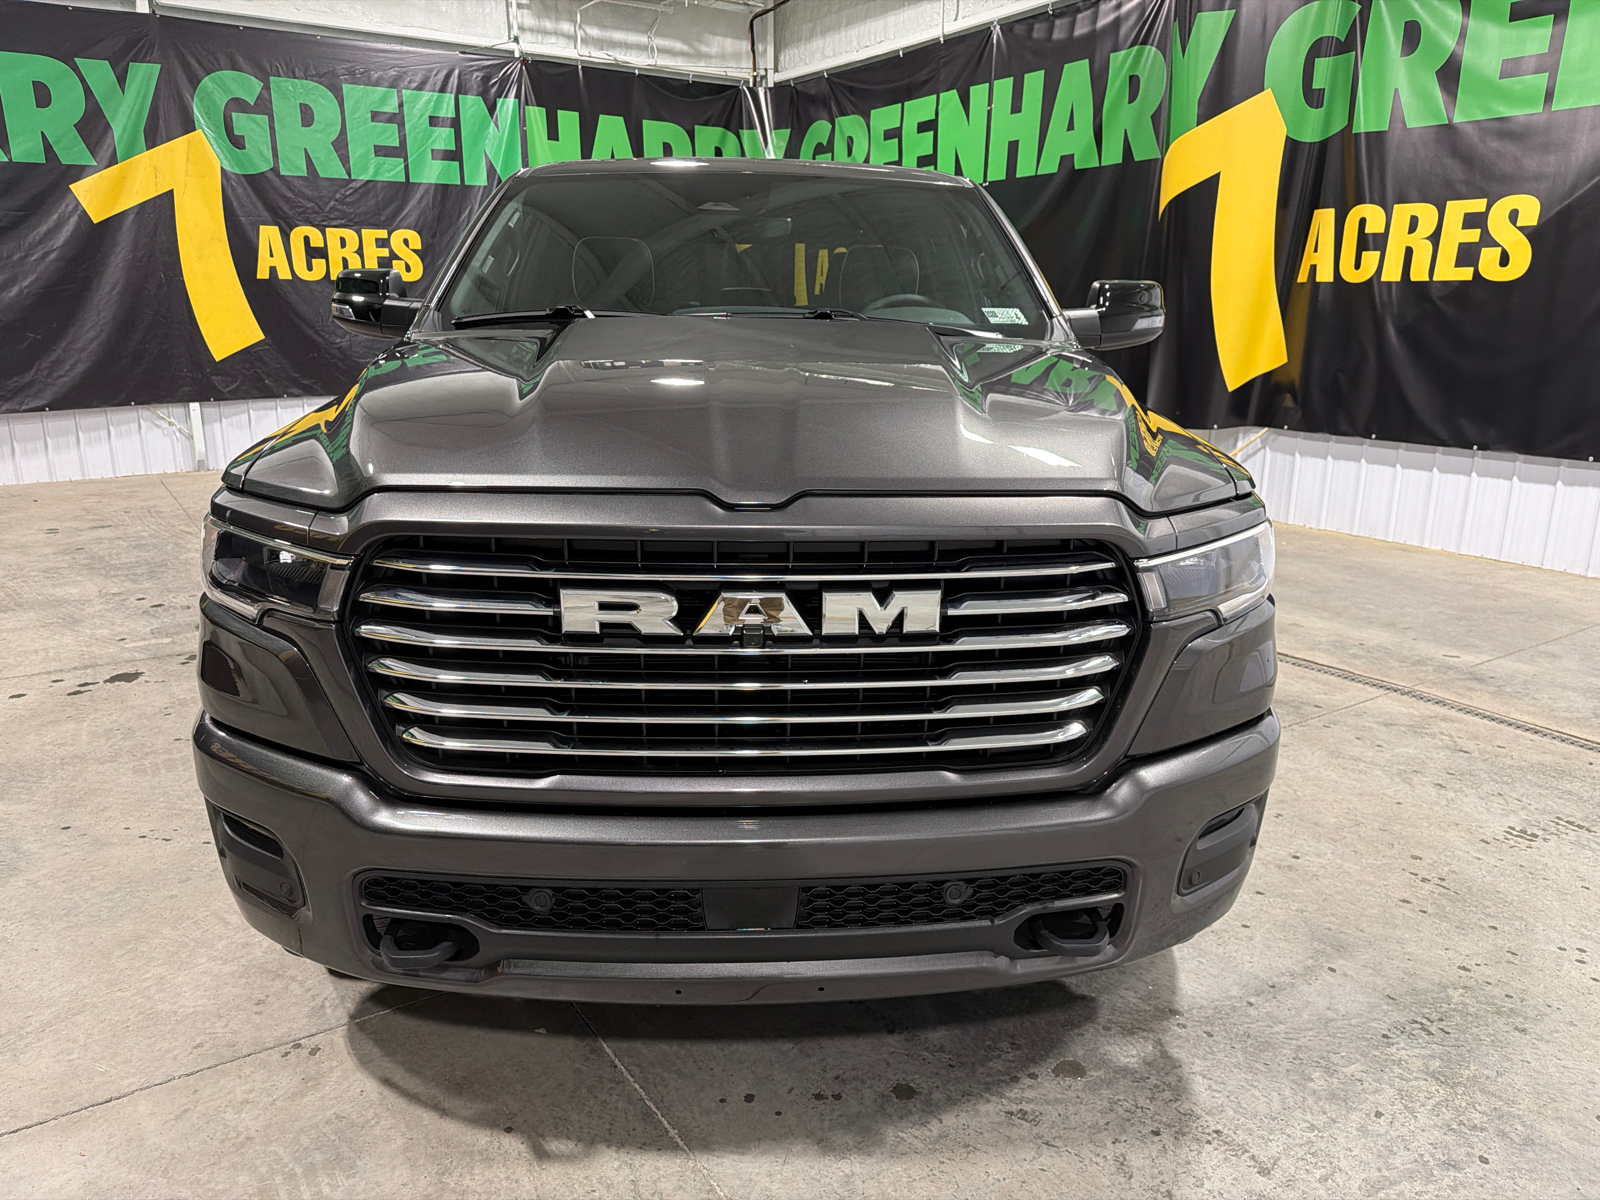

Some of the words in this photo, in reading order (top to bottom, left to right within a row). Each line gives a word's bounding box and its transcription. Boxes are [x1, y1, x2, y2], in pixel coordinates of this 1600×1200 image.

[0, 51, 161, 166] RY
[193, 70, 521, 186] GREEN
[69, 129, 265, 362] 7
[256, 225, 424, 282] ACRES
[1159, 88, 1288, 392] 7
[1297, 194, 1541, 283] ACRES
[560, 588, 943, 635] RAM
